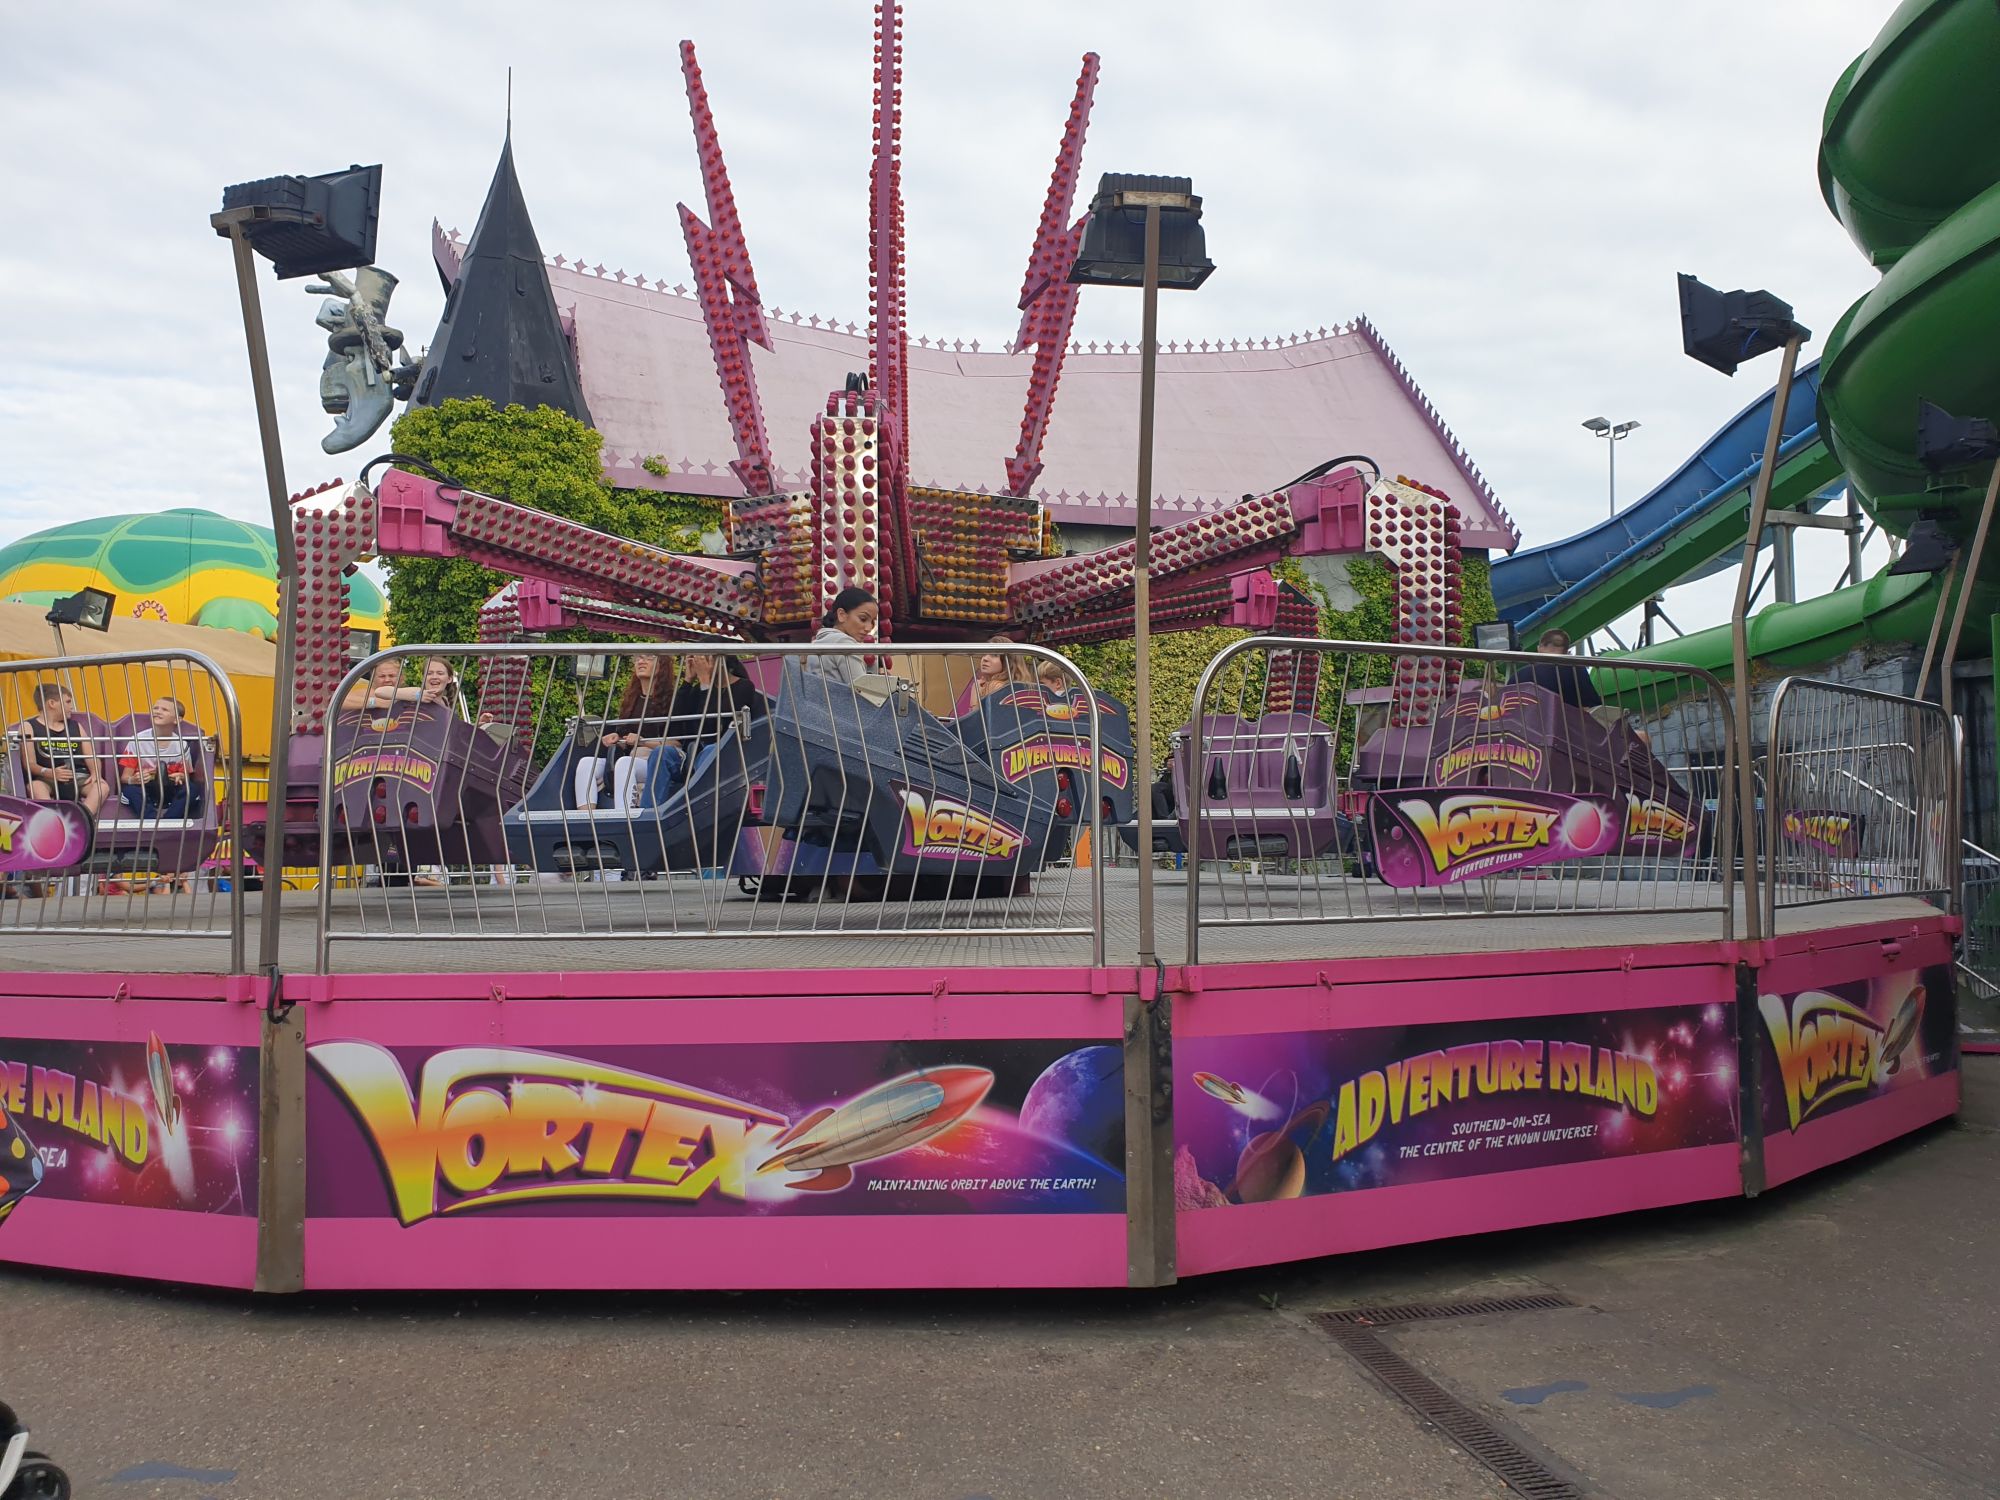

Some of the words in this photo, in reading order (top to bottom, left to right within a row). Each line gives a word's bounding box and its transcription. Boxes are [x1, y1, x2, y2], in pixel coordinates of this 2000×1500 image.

[1010, 745, 1078, 777] ADVENTURE
[899, 789, 1022, 858] VORTEX
[1399, 795, 1560, 875] VORTEX
[1450, 856, 1495, 882] ADVENTURE
[1496, 852, 1524, 865] ISLAND
[1758, 991, 1887, 1135] VORTEX
[32, 1065, 149, 1165] ISLAND
[305, 1038, 790, 1228] VORTEX
[1332, 1040, 1544, 1162] ADVENTURE
[1547, 1040, 1659, 1116] ISLAND
[1451, 1113, 1551, 1136] SOUTHEND-ON-SEA
[1400, 1145, 1421, 1159] THE
[1423, 1139, 1466, 1156] CENTRE
[1468, 1138, 1481, 1151] OF
[1485, 1135, 1504, 1149] THE
[1507, 1132, 1540, 1146] KNOWN
[1542, 1124, 1599, 1142] UNIVERSE!
[867, 1179, 948, 1191] MAINTAINING
[951, 1179, 988, 1190] ORBIT
[989, 1179, 1027, 1190] ABOVE
[1029, 1178, 1051, 1190] THE
[1053, 1178, 1097, 1189] EARTH!
